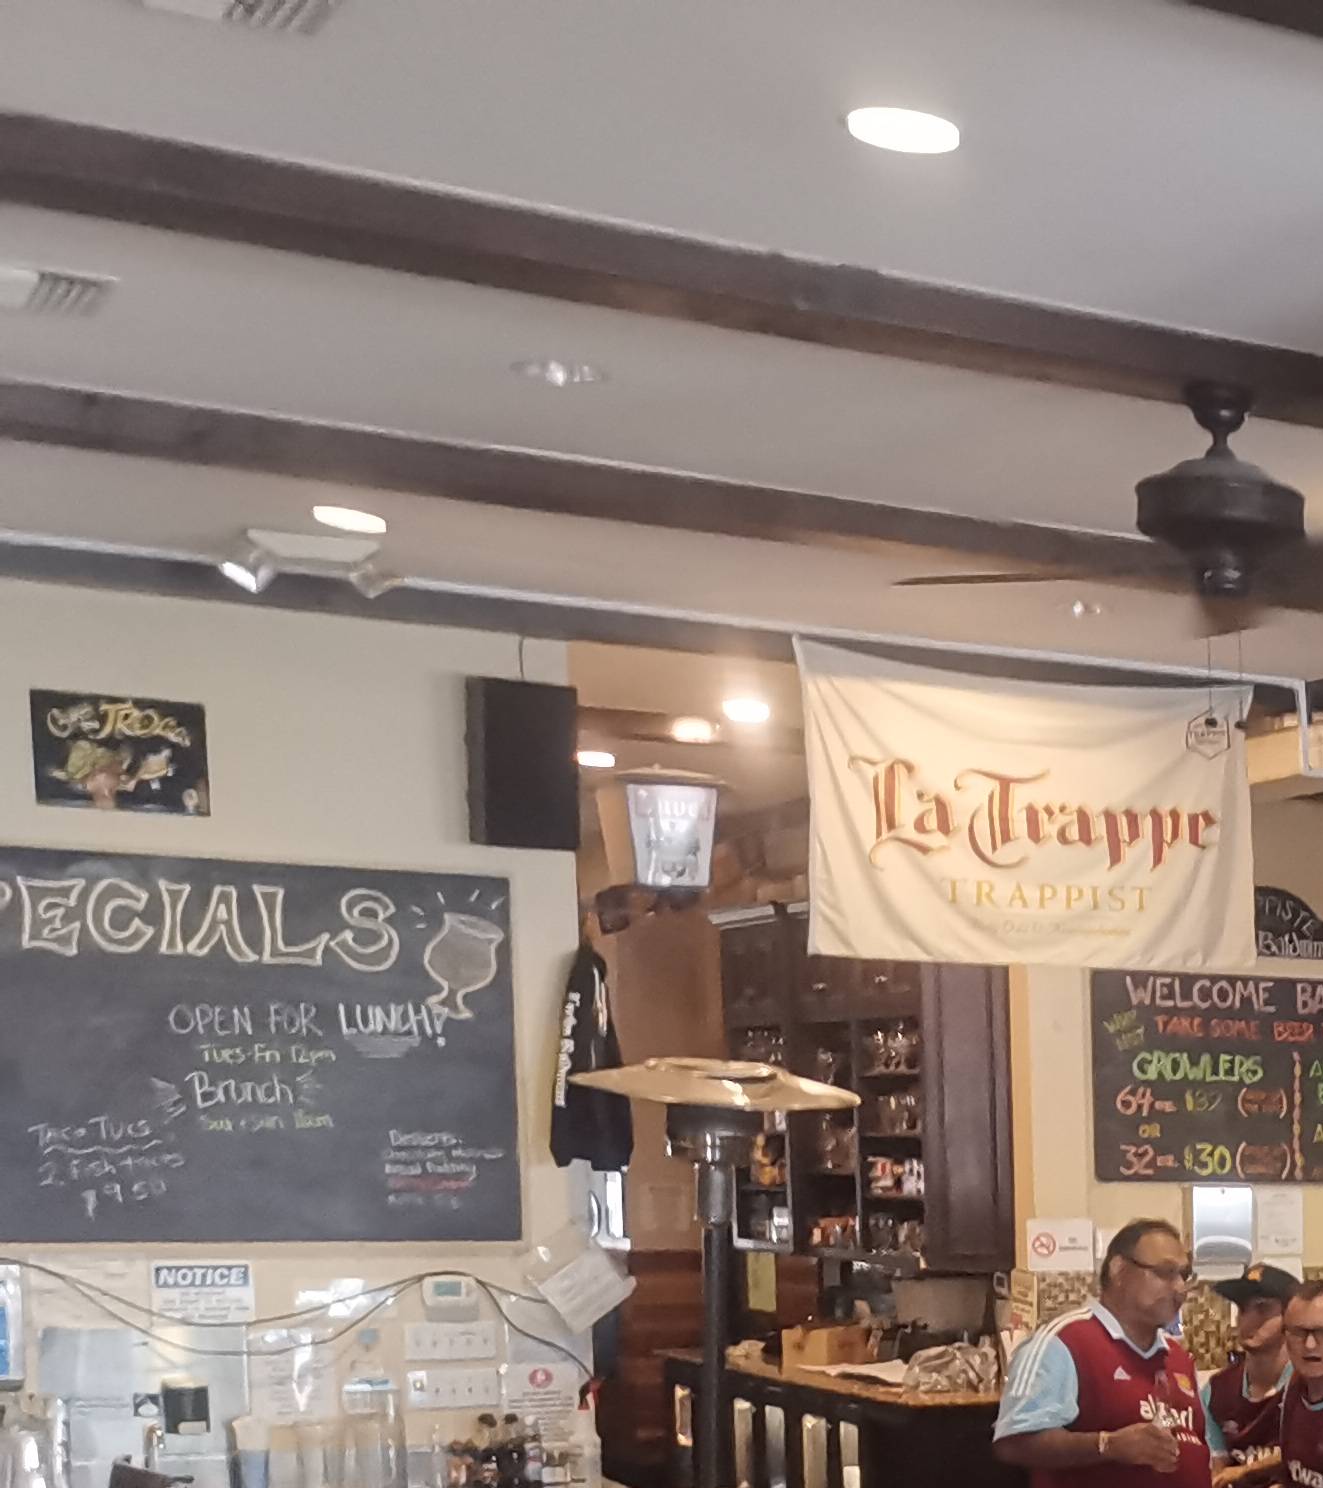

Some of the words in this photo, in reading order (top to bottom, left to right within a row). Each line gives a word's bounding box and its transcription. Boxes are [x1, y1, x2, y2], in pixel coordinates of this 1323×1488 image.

[847, 756, 960, 870] La
[953, 767, 1219, 872] Trappe
[940, 877, 1153, 914] TRAPPIST
[1126, 976, 1277, 1014] WELCOME
[168, 1002, 253, 1036] OPEN
[268, 1002, 323, 1036] FOR
[1154, 1014, 1203, 1037] TAKE
[1211, 1018, 1261, 1041] SOME
[1273, 1020, 1314, 1043] BEER
[1132, 1051, 1265, 1083] GROWLERS
[184, 1069, 294, 1109] Brunch
[157, 1267, 246, 1286] NOTICE
